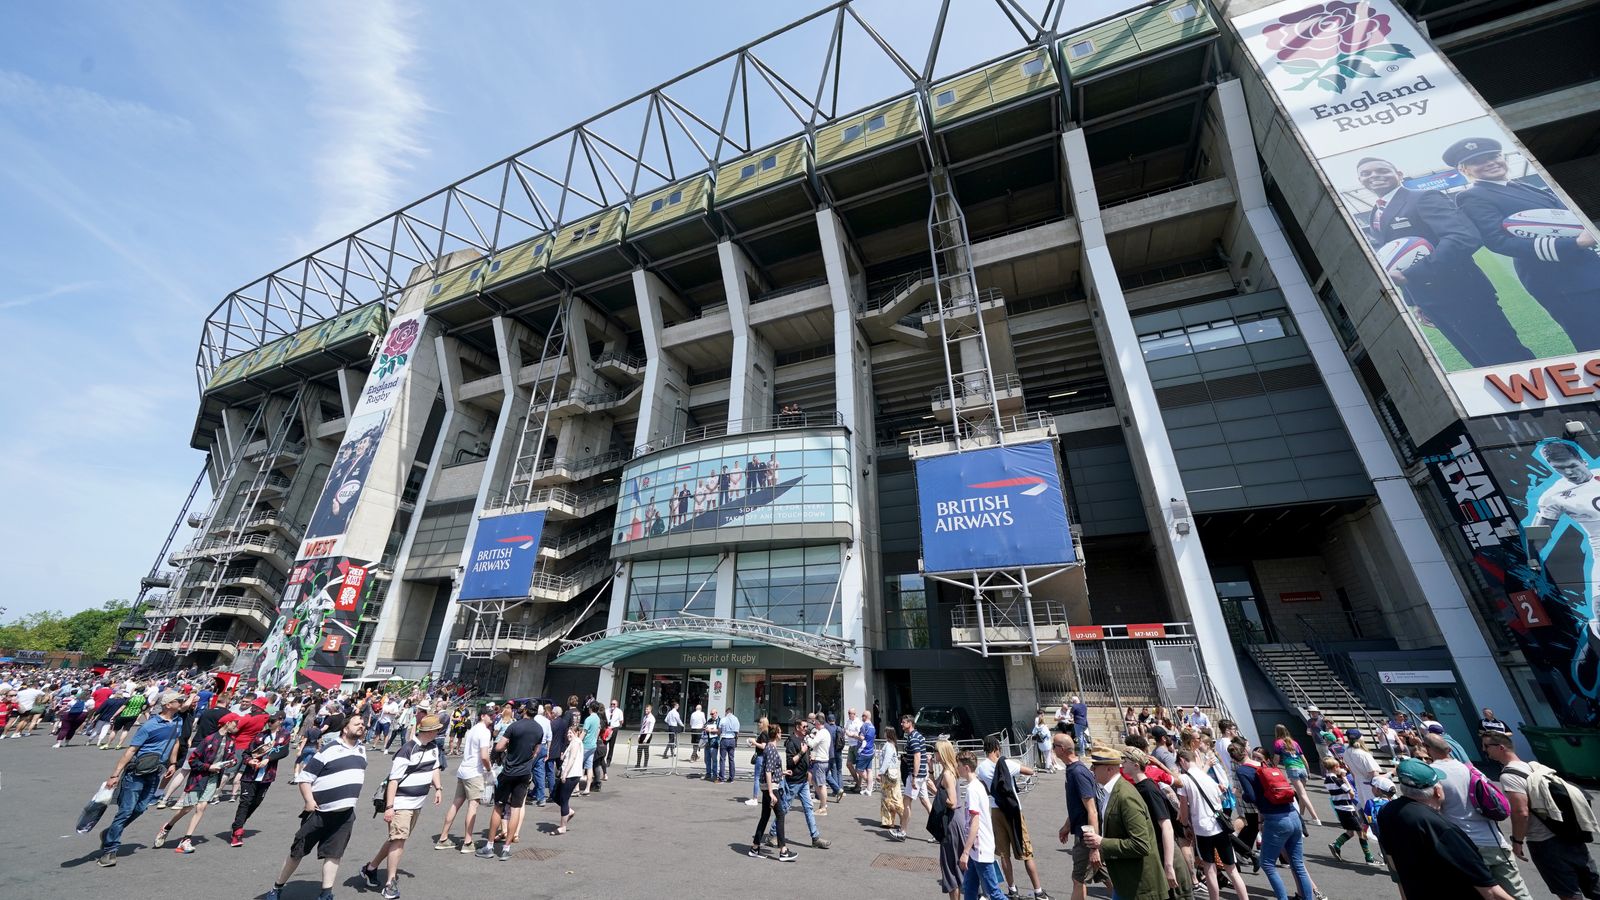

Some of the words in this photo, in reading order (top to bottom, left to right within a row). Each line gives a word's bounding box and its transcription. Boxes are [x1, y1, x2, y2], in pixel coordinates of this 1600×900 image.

[1310, 75, 1436, 120] England
[1332, 99, 1429, 132] Rugby
[367, 376, 399, 395] England
[366, 390, 391, 404] Rugby
[937, 494, 1010, 517] BRITISH
[935, 510, 1014, 533] AIRWAYS
[304, 539, 337, 557] WEST
[477, 547, 513, 561] BRITISH
[472, 559, 510, 573] AIRWAYS
[1520, 602, 1540, 624] 2
[286, 623, 293, 633] 3
[327, 639, 337, 650] 3
[682, 654, 696, 662] The
[698, 653, 719, 664] Spirit
[720, 653, 730, 662] of
[731, 653, 757, 665] Rugby
[1384, 674, 1392, 682] 2
